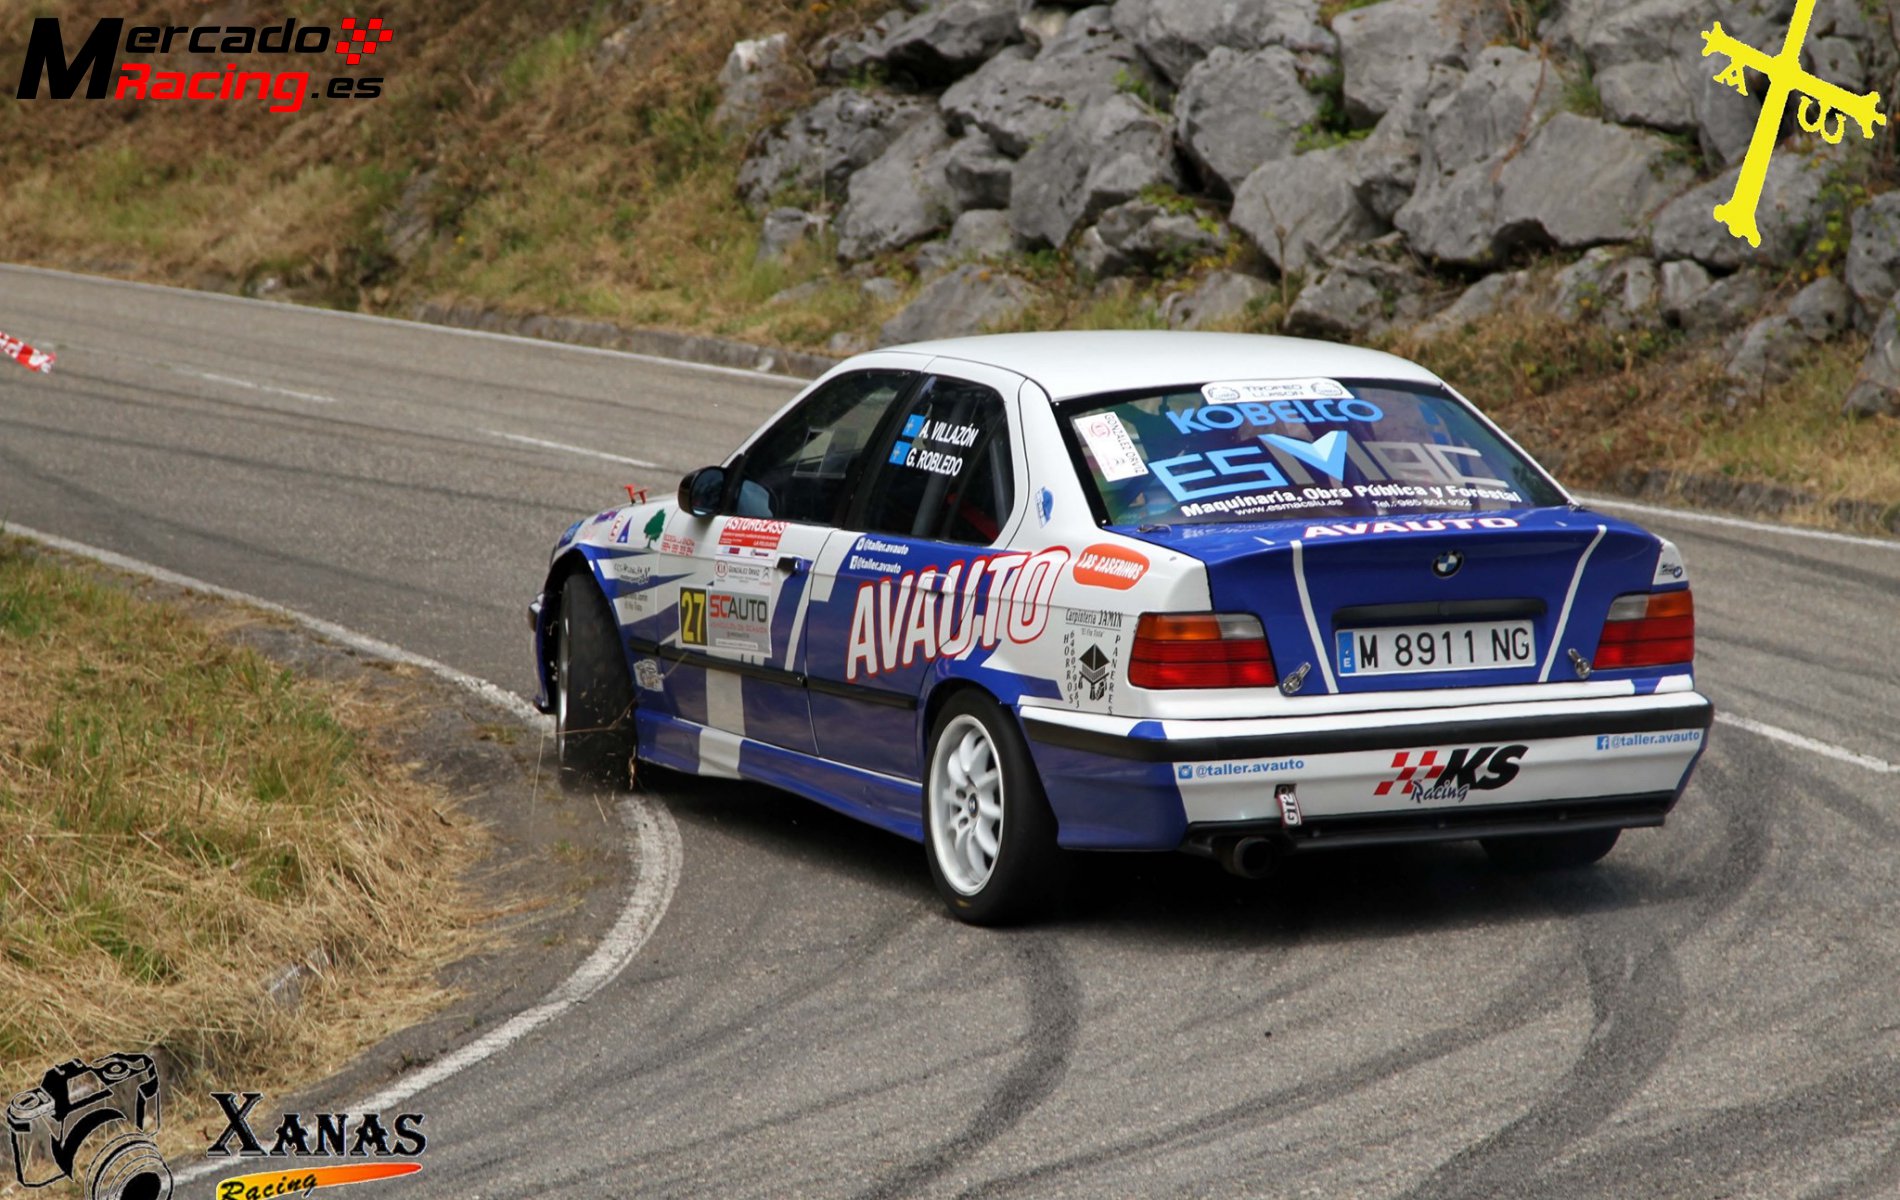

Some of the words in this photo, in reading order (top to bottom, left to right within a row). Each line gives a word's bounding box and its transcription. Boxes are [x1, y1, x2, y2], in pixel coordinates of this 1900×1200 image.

[1166, 399, 1384, 435] KOBELCO
[918, 419, 931, 439] A.
[931, 421, 979, 448] VILLAZÓN
[905, 447, 918, 467] G.
[916, 449, 963, 477] ROBLEDO
[1148, 430, 1509, 502] ESMAC
[1180, 490, 1303, 518] Maquinaria,
[1303, 486, 1352, 500] Obra
[1353, 484, 1428, 498] Pública
[1430, 486, 1443, 499] y
[1445, 485, 1523, 503] Forestal
[1303, 516, 1519, 539] AVAUTO
[682, 590, 705, 643] 27
[709, 593, 767, 623] SCAUTO
[845, 545, 1072, 684] AVAUTO
[1358, 634, 1379, 669] M
[1395, 629, 1475, 667] 8911
[1491, 627, 1530, 662] NG
[1611, 731, 1700, 749] @taller.avauto
[1195, 758, 1305, 778] @taller.avauto
[1432, 744, 1529, 791] KS
[1410, 779, 1471, 804] Racing
